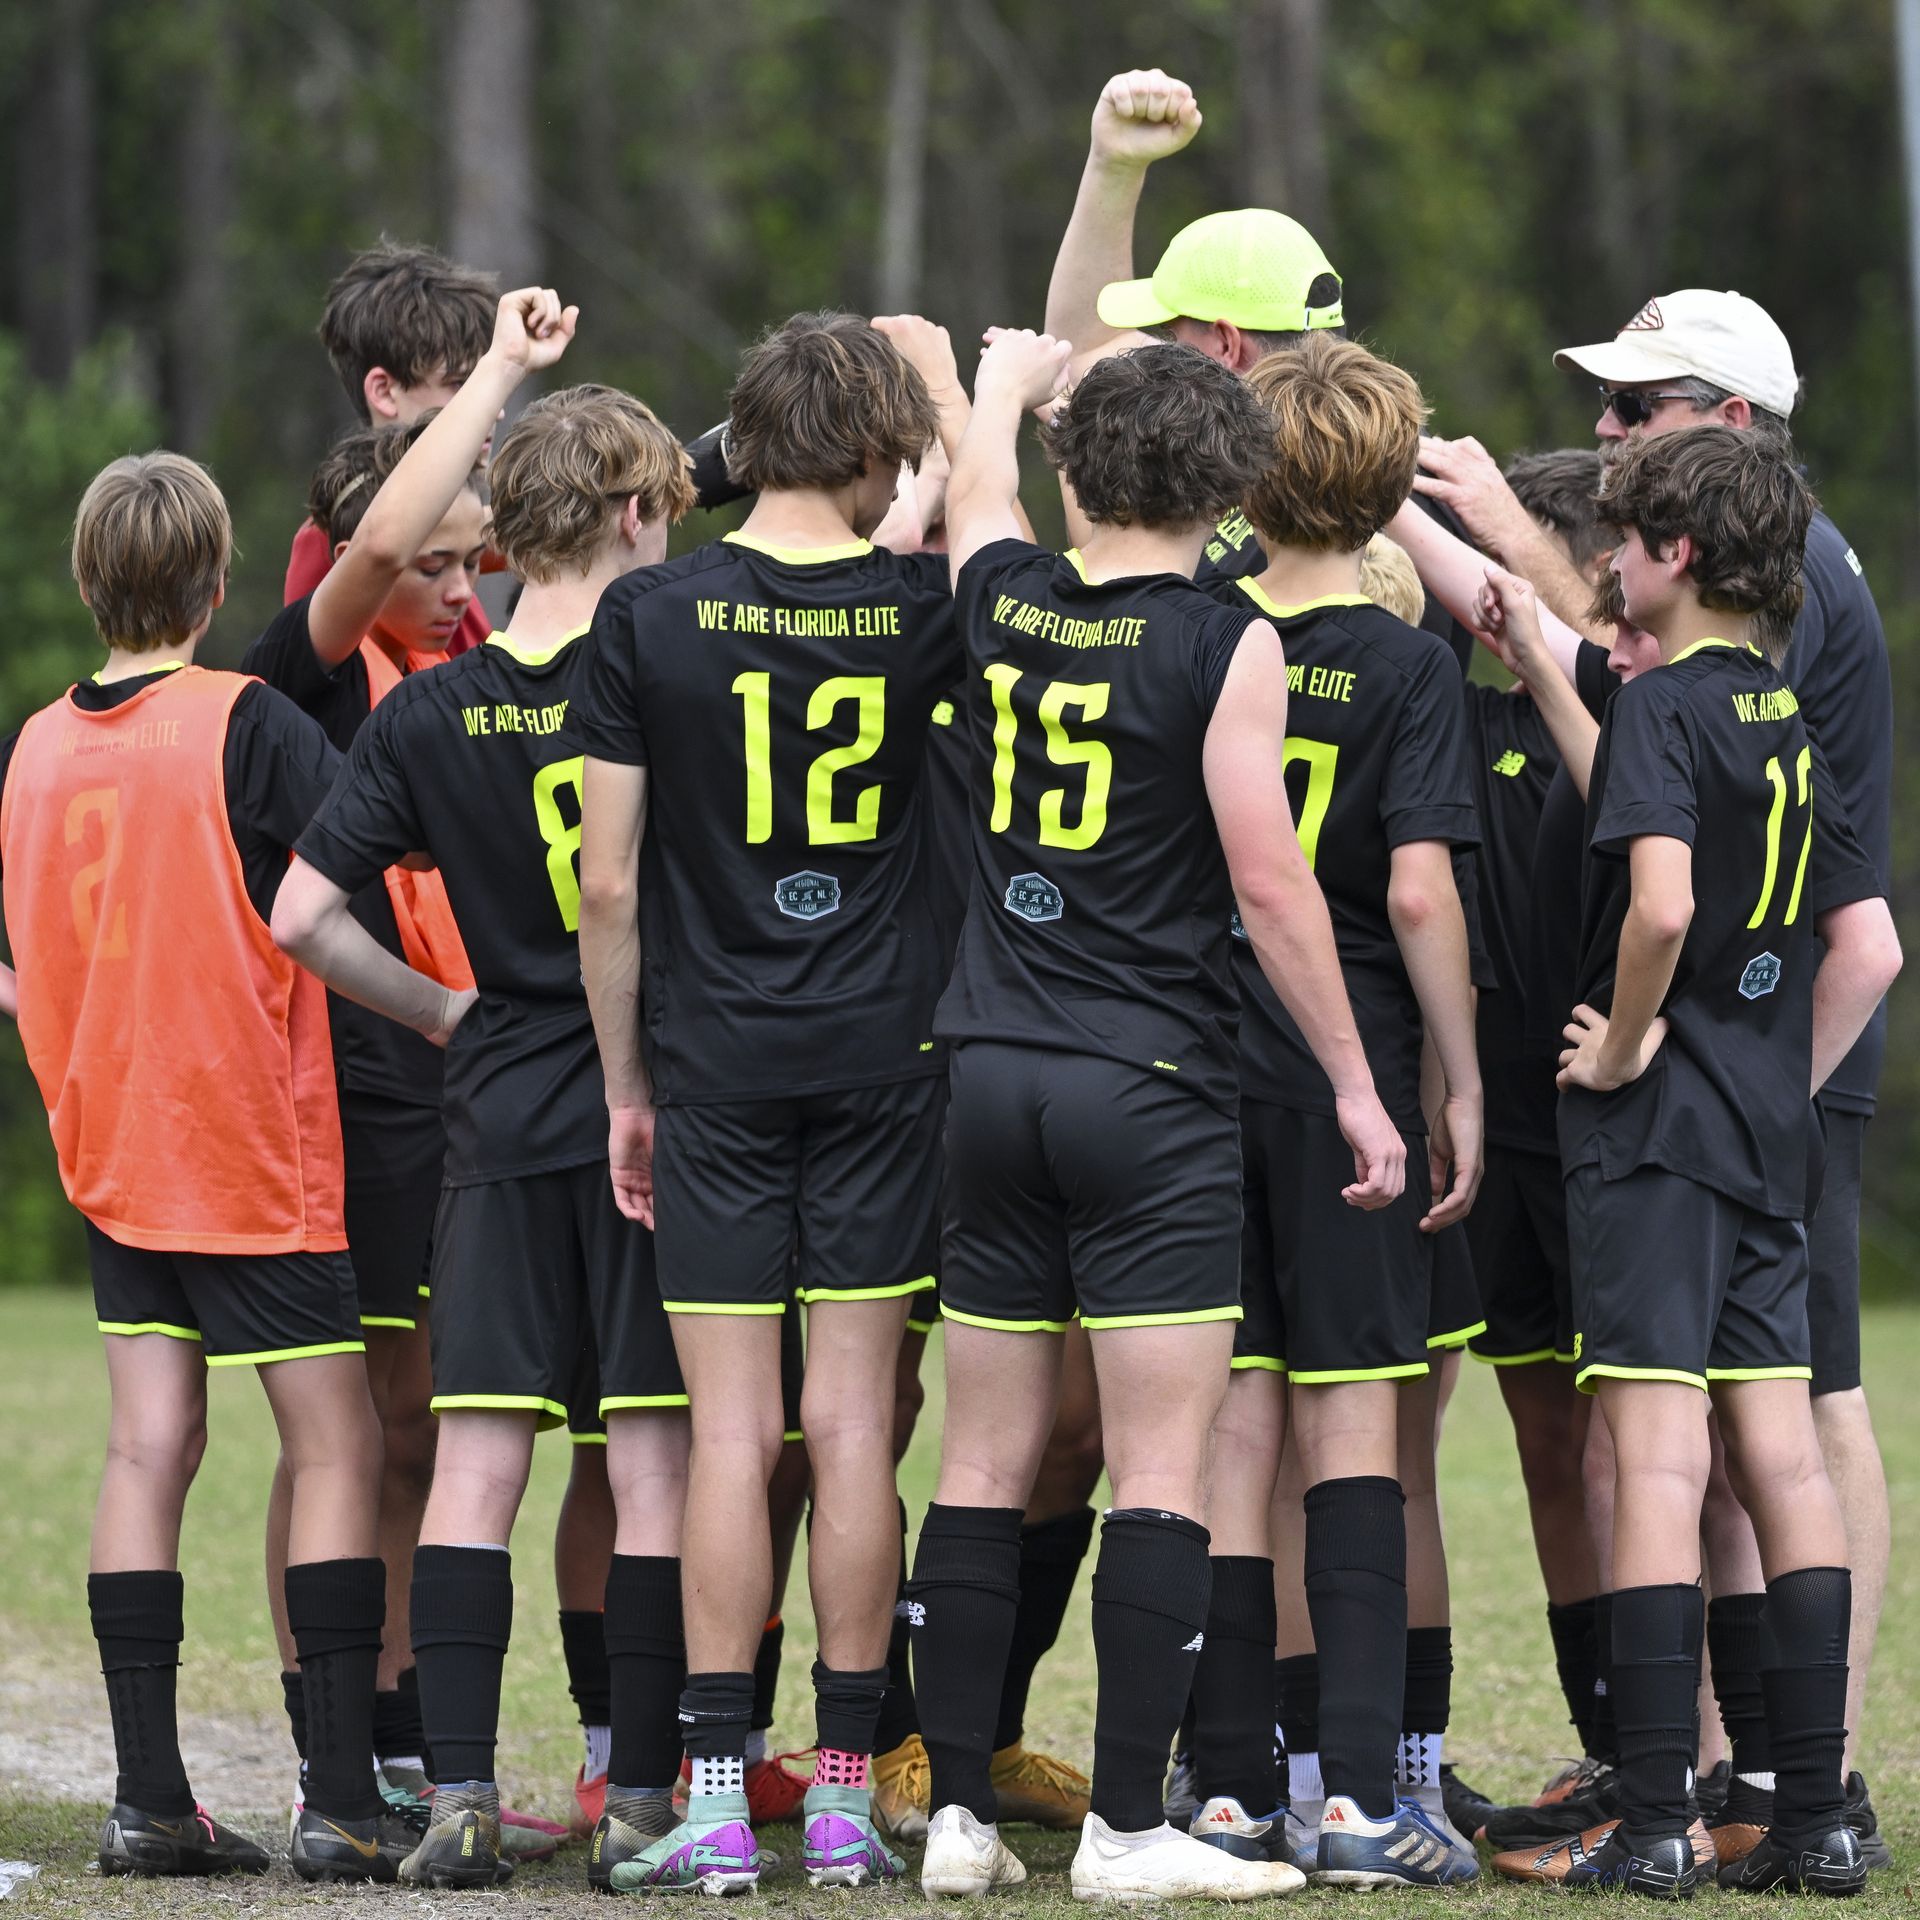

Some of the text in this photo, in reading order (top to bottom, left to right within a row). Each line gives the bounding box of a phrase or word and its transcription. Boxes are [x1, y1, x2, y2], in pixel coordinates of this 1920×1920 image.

[697, 600, 901, 637] WE ARE FLORIDA ELITE
[1009, 603, 1046, 636] ARE
[1104, 617, 1147, 647] ELITE
[1308, 666, 1356, 703] ELITE
[461, 706, 491, 736] WE
[495, 704, 524, 733] ARE
[1731, 693, 1760, 723] WE
[139, 719, 181, 750] ELITE
[732, 672, 885, 845] 12
[984, 664, 1112, 850] 15
[64, 787, 130, 961] 2
[788, 889, 828, 902] EC NL
[1018, 890, 1027, 901] EC
